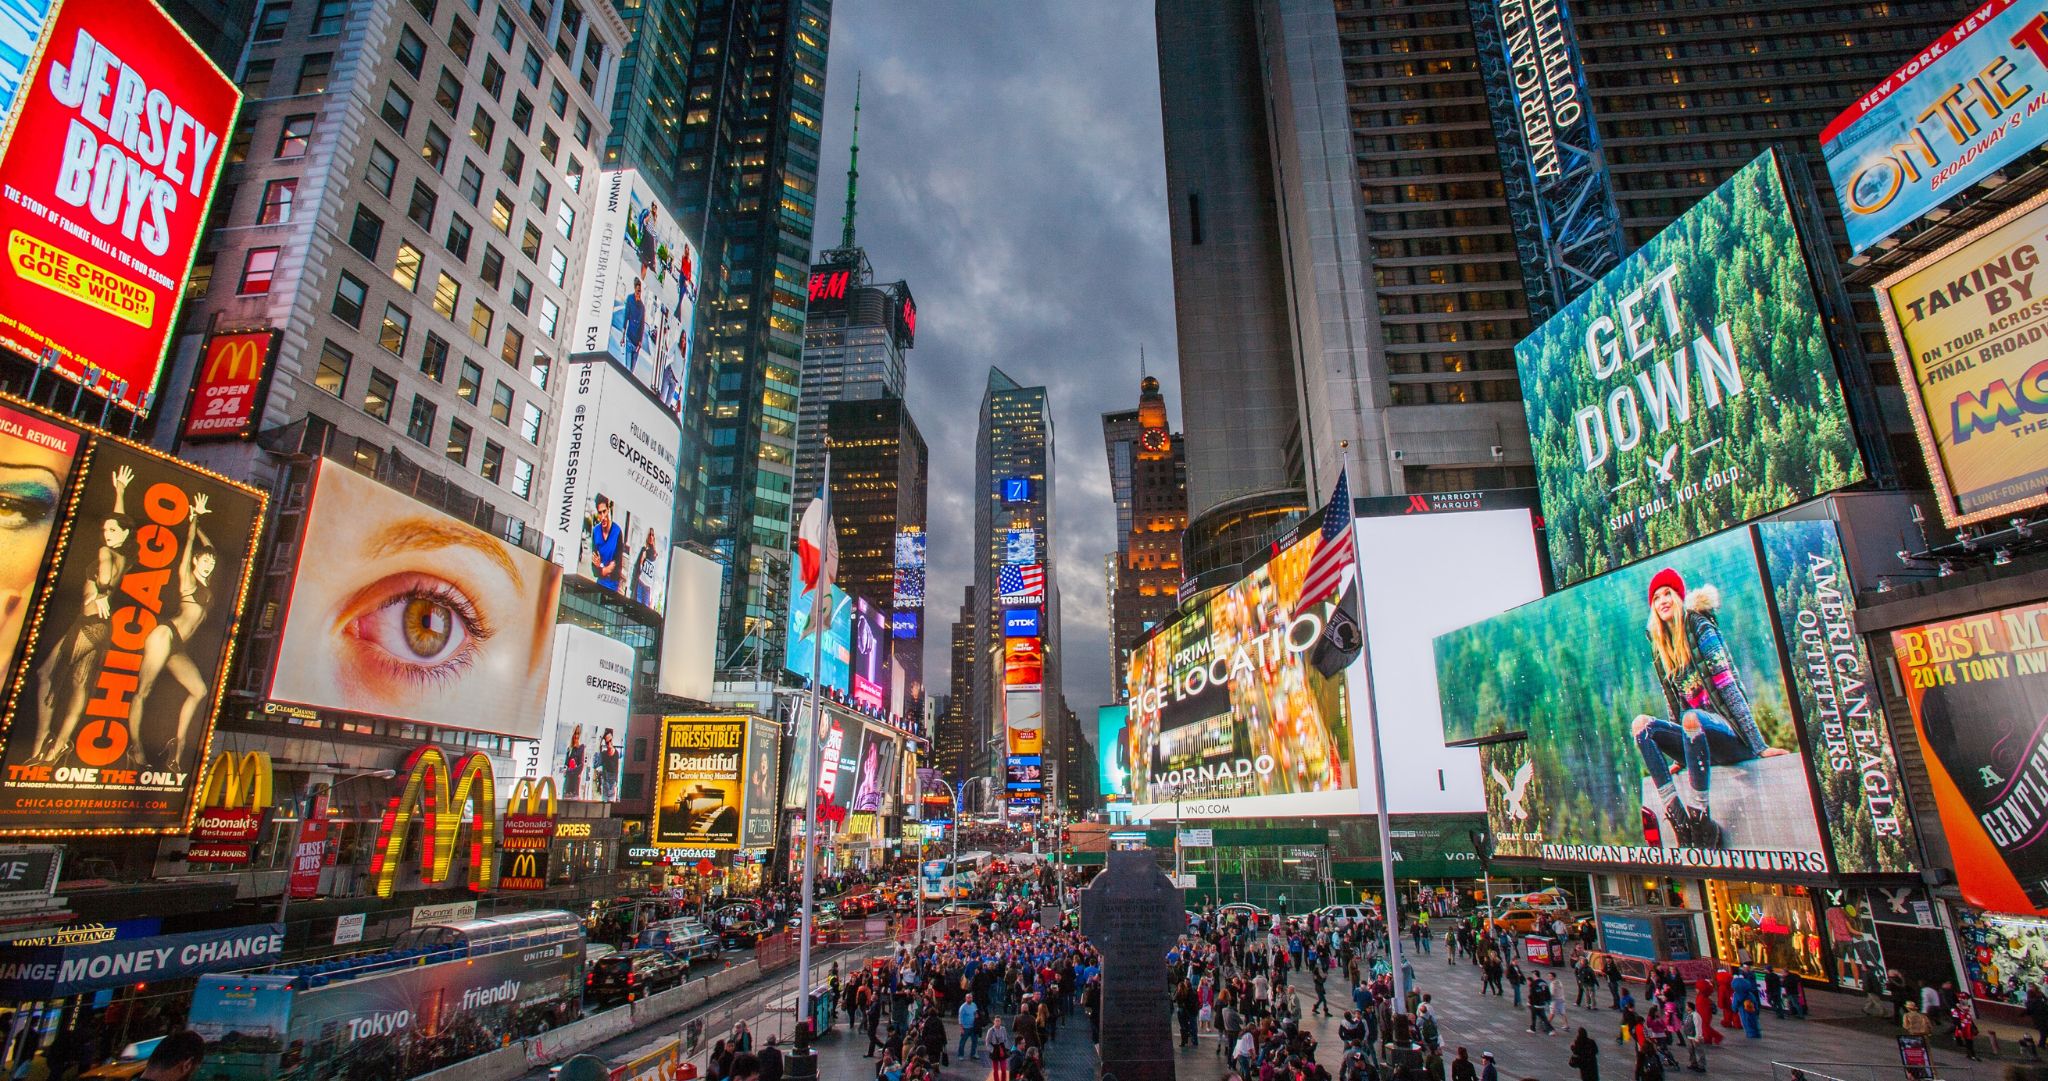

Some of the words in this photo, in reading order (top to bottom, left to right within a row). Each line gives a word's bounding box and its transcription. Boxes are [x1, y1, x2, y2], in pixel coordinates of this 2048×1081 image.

[1860, 81, 1892, 112] NEW
[1896, 42, 1949, 83] YORK,
[1953, 4, 1993, 41] NEW
[49, 27, 218, 198] JERSEY
[1506, 28, 1561, 177] AMERICAN
[1847, 128, 1941, 214] ON
[1917, 55, 2032, 145] THE
[1931, 112, 2021, 191] BROADWAY'S
[56, 118, 177, 256] BOYS
[3, 184, 21, 204] THE
[21, 195, 49, 220] STORY
[48, 212, 60, 226] OF
[59, 216, 91, 244] FRANKIE
[91, 231, 110, 253] VALLI
[118, 250, 132, 267] THE
[131, 257, 148, 276] FOUR
[147, 264, 175, 291] SEASONS
[18, 254, 81, 290] GOES
[75, 262, 148, 304] CROWD
[808, 271, 849, 302] H&M
[1906, 245, 2039, 322] TAKING
[1985, 271, 2034, 316] BY
[1584, 263, 1682, 381] GET
[1921, 348, 1942, 365] ON
[1943, 327, 1984, 355] TOUR
[1926, 356, 1976, 386] FINAL
[206, 384, 250, 397] OPEN
[1575, 320, 1745, 473] DOWN
[205, 397, 241, 416] 24
[192, 416, 247, 430] HOURS
[2010, 417, 2048, 439] THE
[26, 424, 68, 453] REVIVAL
[558, 403, 588, 534] @EXPRESSRUNWAY
[1432, 491, 1484, 502] MARRIOTT
[1432, 500, 1481, 511] MARQUIS
[1611, 511, 1636, 532] STAY
[1638, 498, 1673, 520] COOL.
[1675, 482, 1700, 503] NOT
[1704, 465, 1746, 493] COLD.
[1001, 596, 1042, 605] TOSHIBA
[76, 482, 190, 766] CHICAGO
[1175, 632, 1221, 669] PRIME
[1900, 618, 1996, 668] BEST
[1911, 663, 1958, 689] 2014
[1957, 656, 2010, 683] TONY
[1796, 610, 1853, 773] OUTFITTERS
[1807, 552, 1873, 719] AMERICAN
[1850, 727, 1902, 837] EAGLE
[670, 731, 742, 748] IRRESISTIBLE!
[8, 765, 52, 782] THE
[55, 767, 99, 782] ONE
[101, 769, 138, 784] THE
[141, 771, 187, 786] ONLY
[669, 752, 739, 772] Beautiful
[669, 771, 681, 780] The
[714, 772, 737, 780] Musical
[1155, 754, 1274, 790] VORNADO
[1979, 765, 2005, 788] A
[1210, 781, 1253, 791] TRUST
[16, 798, 168, 809] CHICAGOTHEMUSICAL.COM
[196, 817, 258, 830] McDonald's
[201, 829, 245, 837] Restaurant
[505, 820, 552, 829] McDonald's
[1496, 831, 1521, 842] GREAT
[189, 849, 208, 857] OPEN
[221, 850, 247, 858] HOURS
[297, 840, 327, 857] JERSEY
[299, 855, 321, 871] BOYS
[629, 848, 659, 857] GIFTS
[666, 849, 717, 859] LUGGAGE
[1543, 844, 1622, 864] AMERICAN
[1627, 846, 1684, 868] EAGLE
[1687, 847, 1827, 874] OUTFITTERS
[56, 928, 117, 945] EXCHANGE
[57, 948, 174, 984] MONEY
[180, 934, 285, 967] CHANGE
[523, 949, 555, 962] UNITED
[348, 1008, 409, 1043] Tokyo
[463, 979, 522, 1011] friendly
